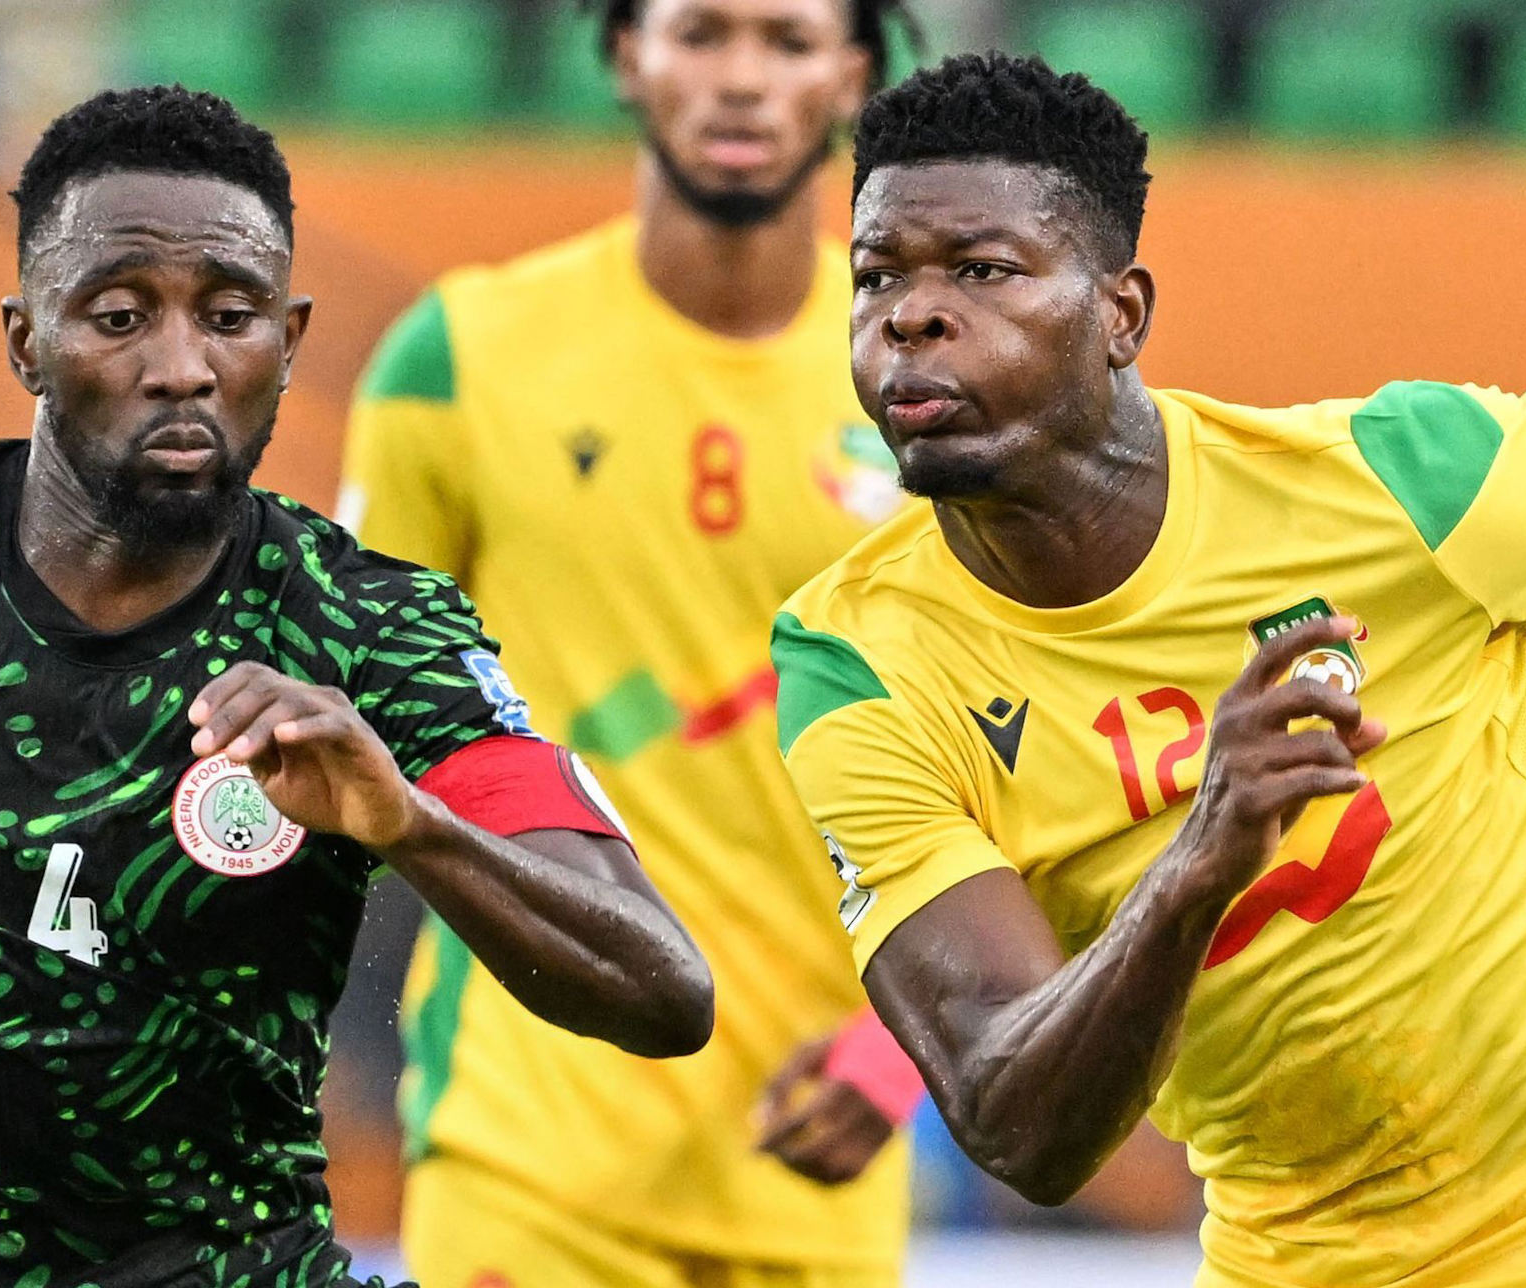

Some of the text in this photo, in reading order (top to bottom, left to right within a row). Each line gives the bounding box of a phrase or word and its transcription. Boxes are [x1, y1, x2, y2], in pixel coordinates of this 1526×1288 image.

[689, 422, 744, 538] 8
[1092, 686, 1206, 822] 12
[179, 789, 203, 849] NIGERIA
[220, 856, 254, 869] 1945
[27, 843, 108, 967] 4
